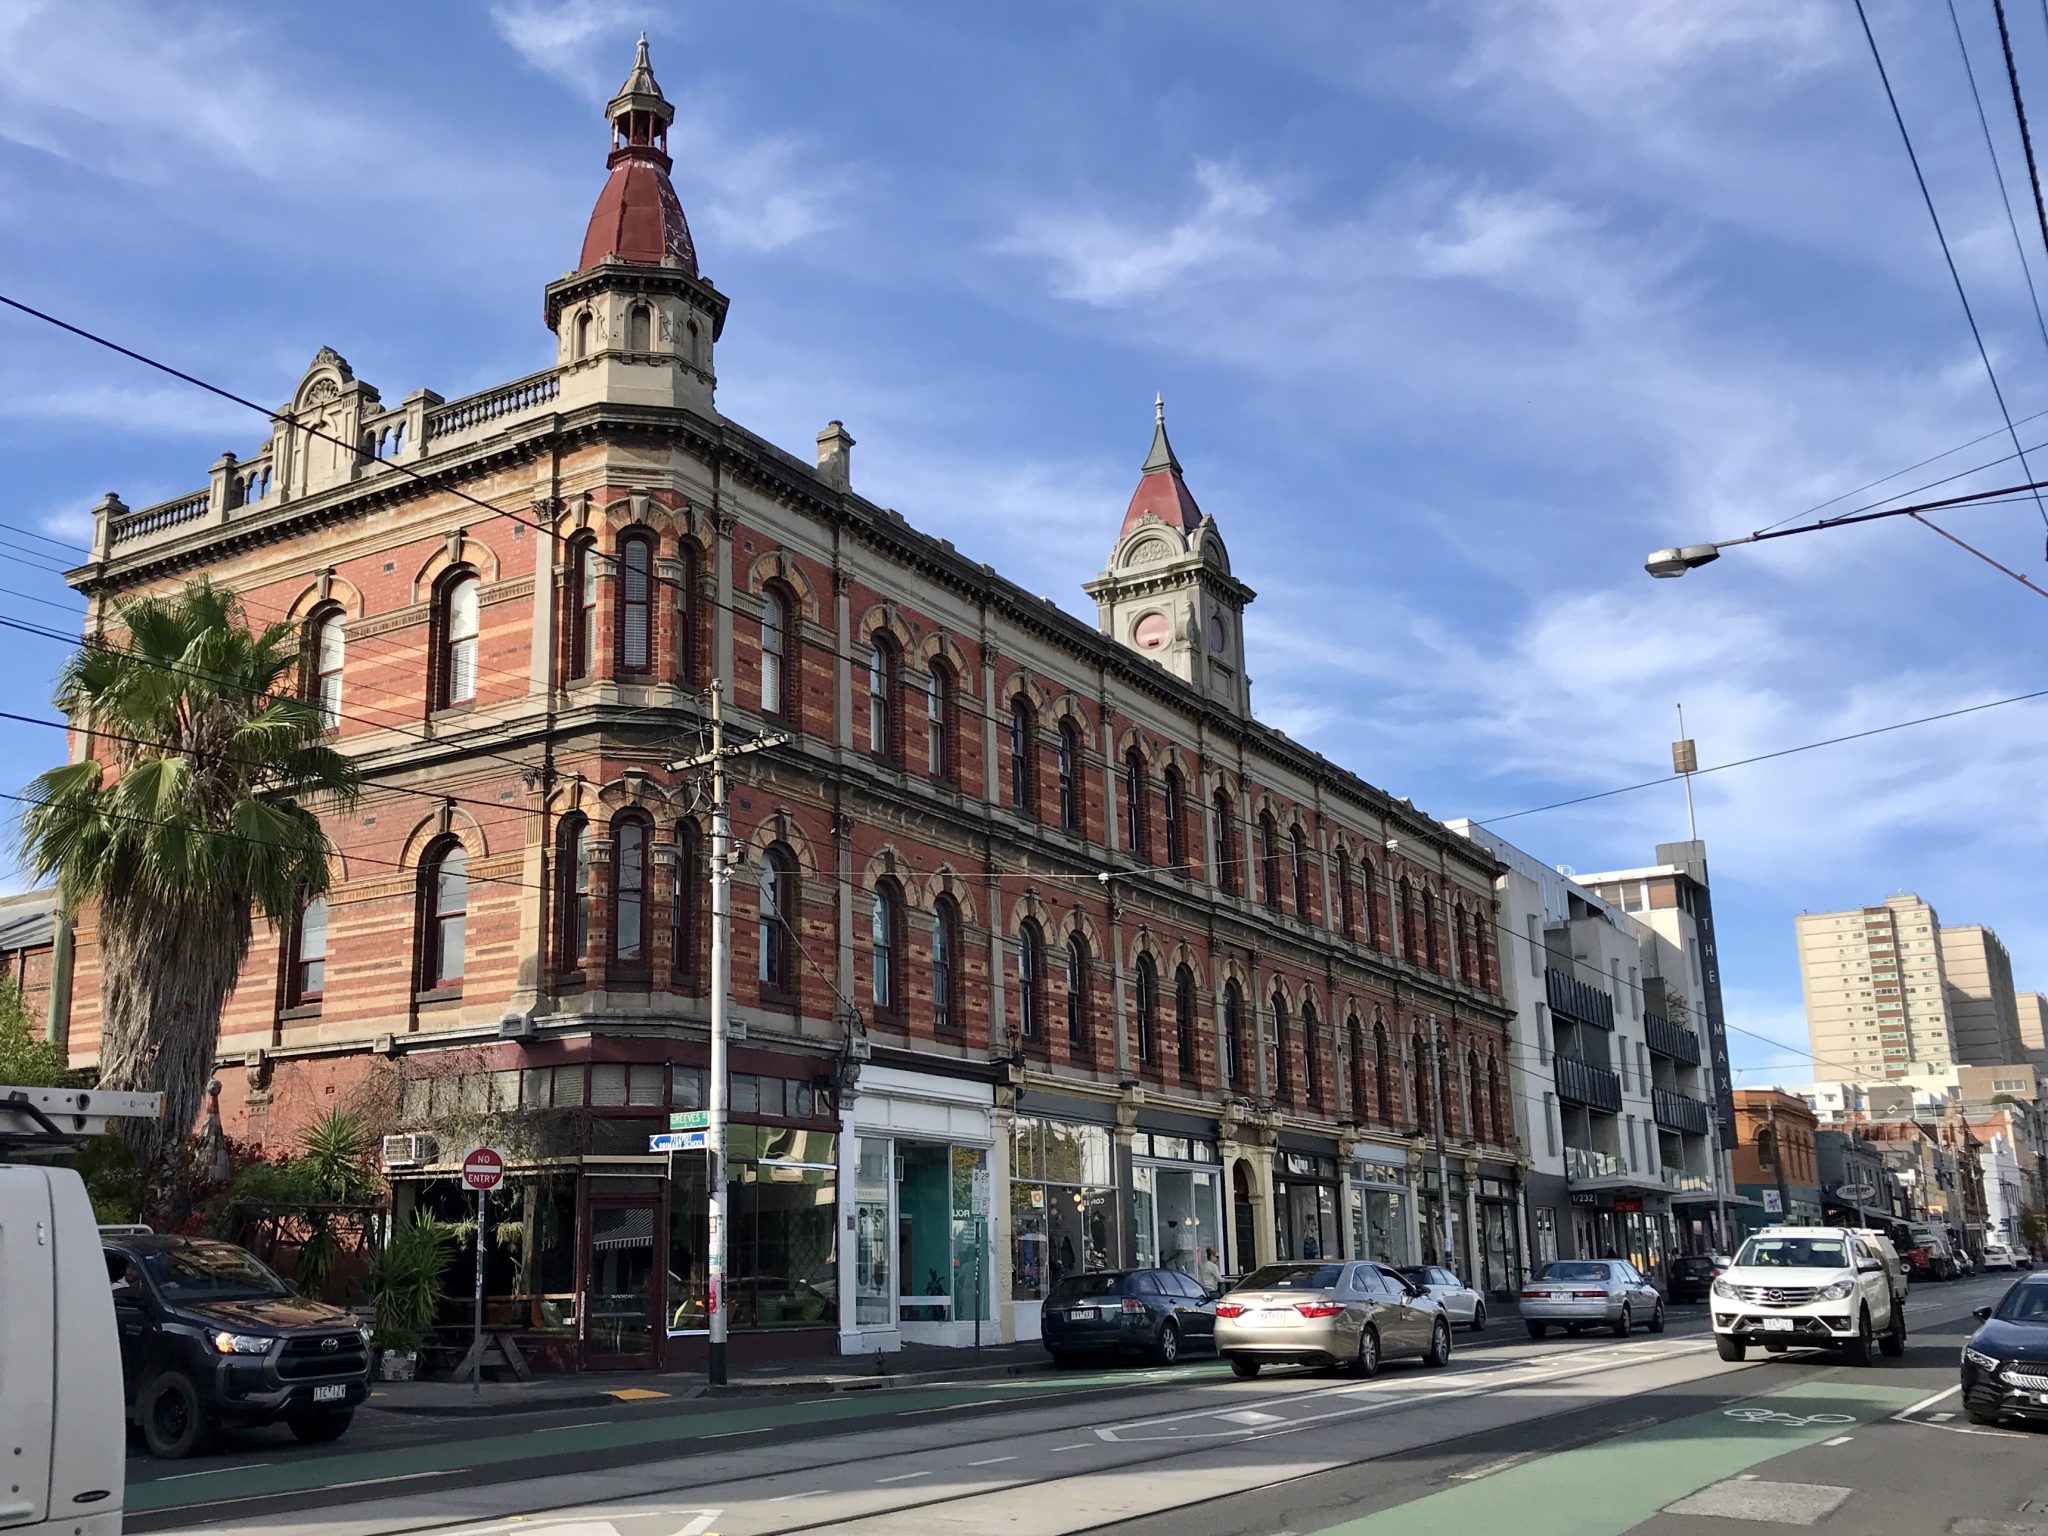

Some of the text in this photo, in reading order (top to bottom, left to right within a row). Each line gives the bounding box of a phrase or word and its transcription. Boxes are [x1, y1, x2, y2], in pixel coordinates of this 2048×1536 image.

[1702, 918, 1728, 1090] THE MAX
[671, 1113, 700, 1125] GREEVES
[477, 1155, 490, 1164] NO
[468, 1174, 497, 1183] ENTRY
[1572, 1194, 1594, 1203] 1/232
